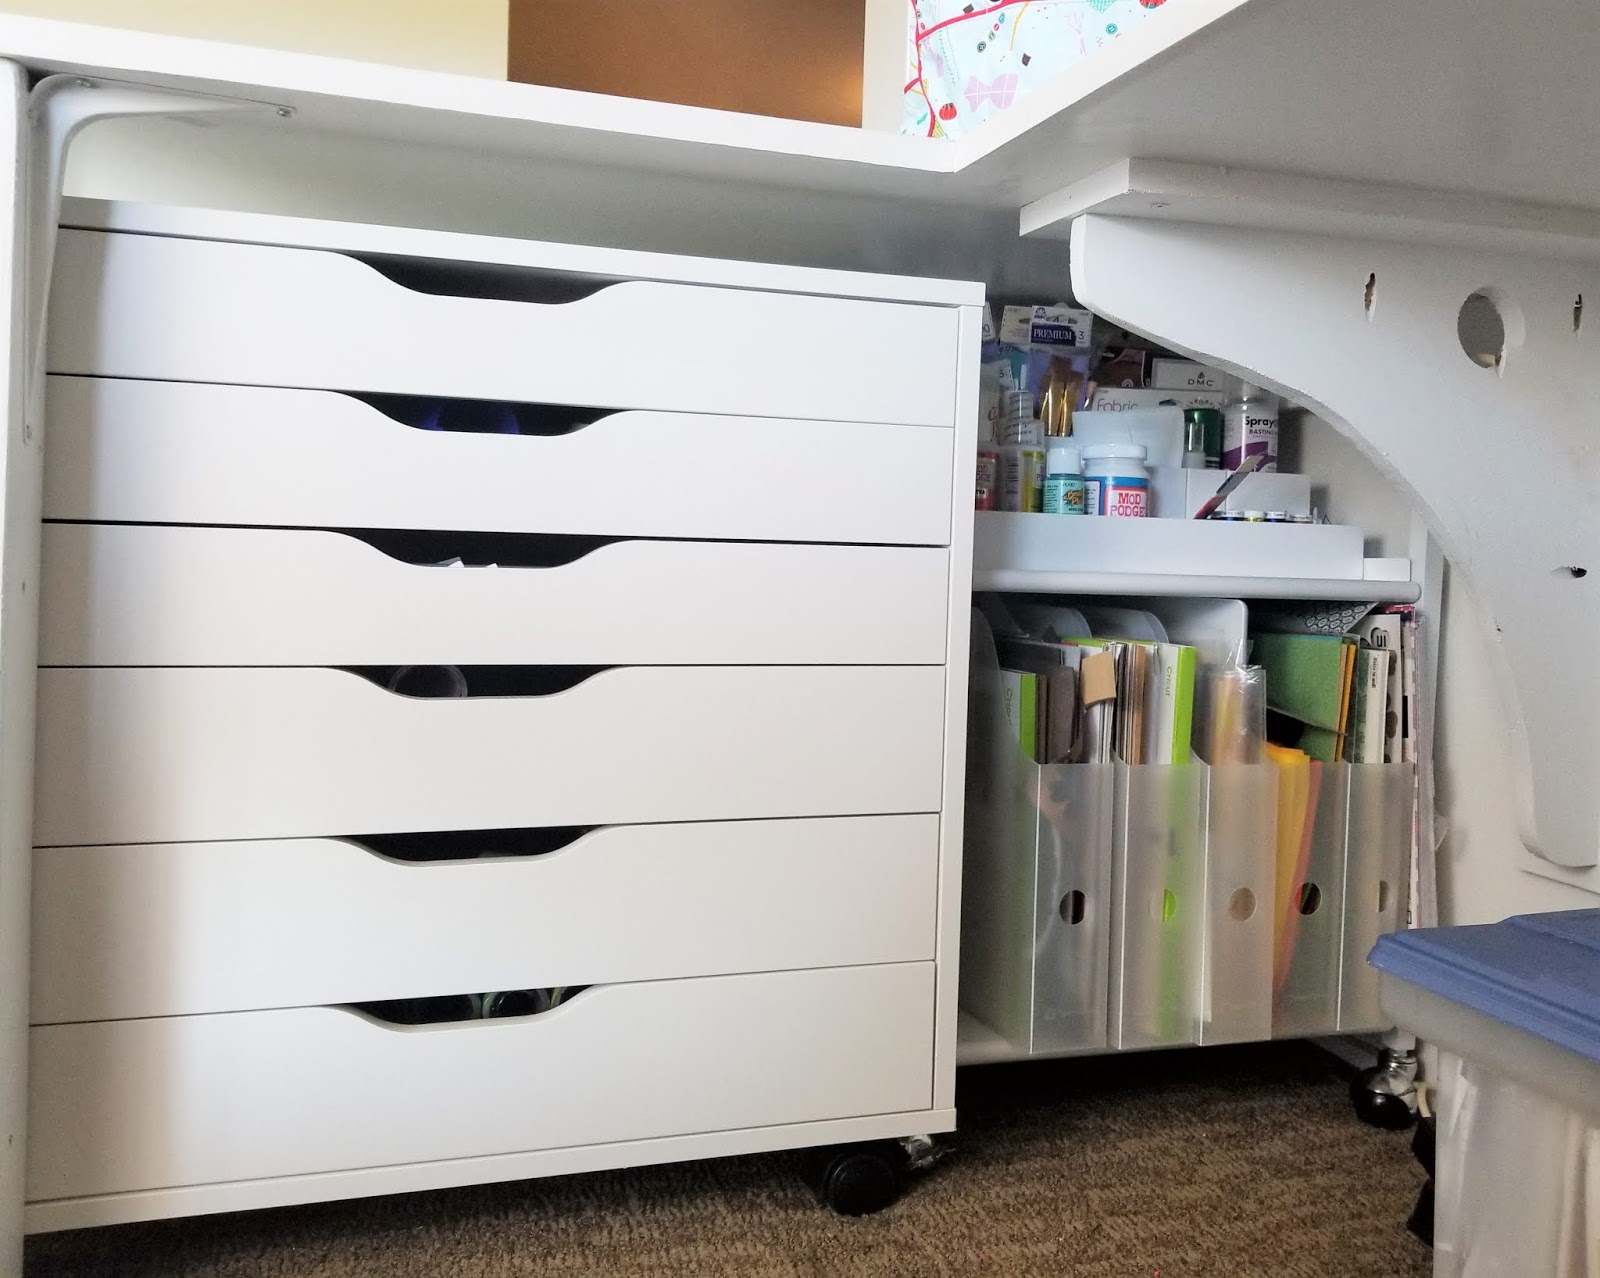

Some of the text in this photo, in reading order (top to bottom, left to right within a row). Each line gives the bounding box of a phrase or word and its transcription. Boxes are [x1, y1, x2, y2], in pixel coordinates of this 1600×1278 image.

[1033, 328, 1072, 340] PREMIUM
[1078, 331, 1085, 340] 3
[1187, 378, 1214, 387] DMC
[1117, 492, 1141, 505] MOD
[1110, 505, 1147, 517] PODGE
